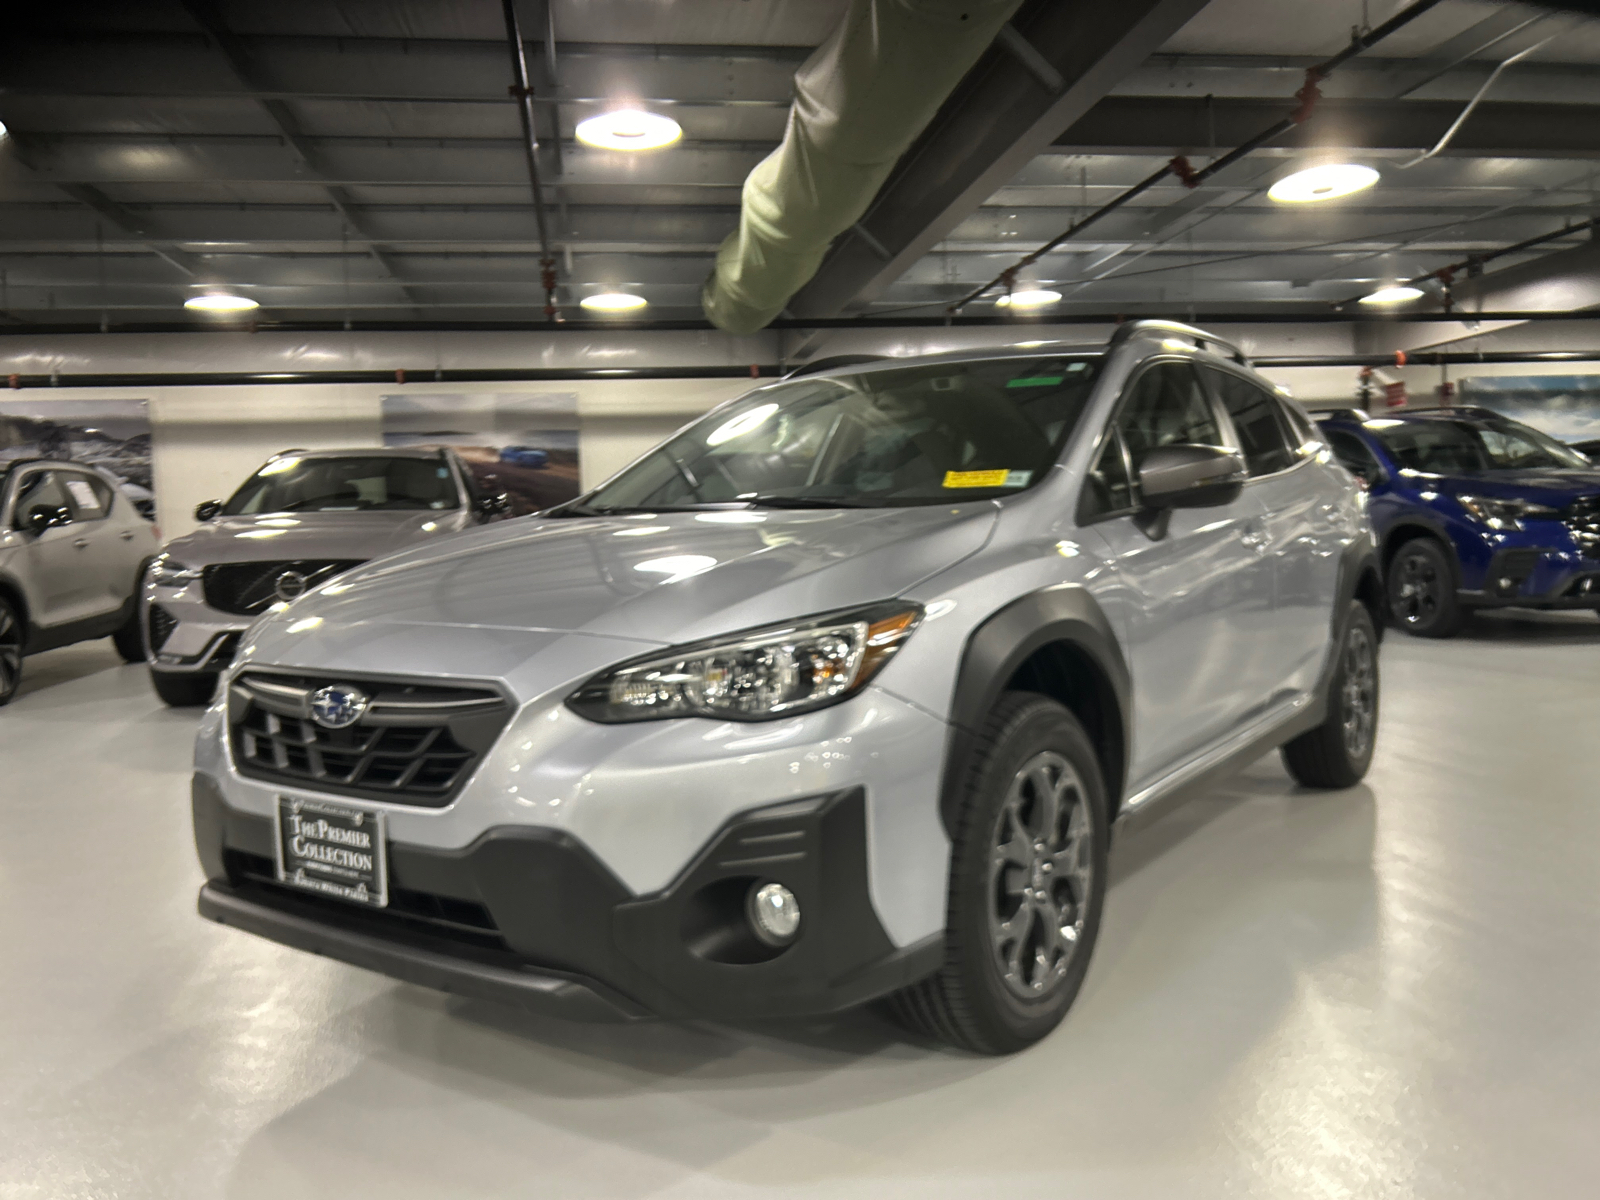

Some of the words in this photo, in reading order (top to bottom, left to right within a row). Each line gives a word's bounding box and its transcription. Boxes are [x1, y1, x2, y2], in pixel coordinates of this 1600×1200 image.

[290, 815, 317, 838] THE
[317, 819, 371, 849] PREMIER
[293, 835, 373, 871] COLLECTION
